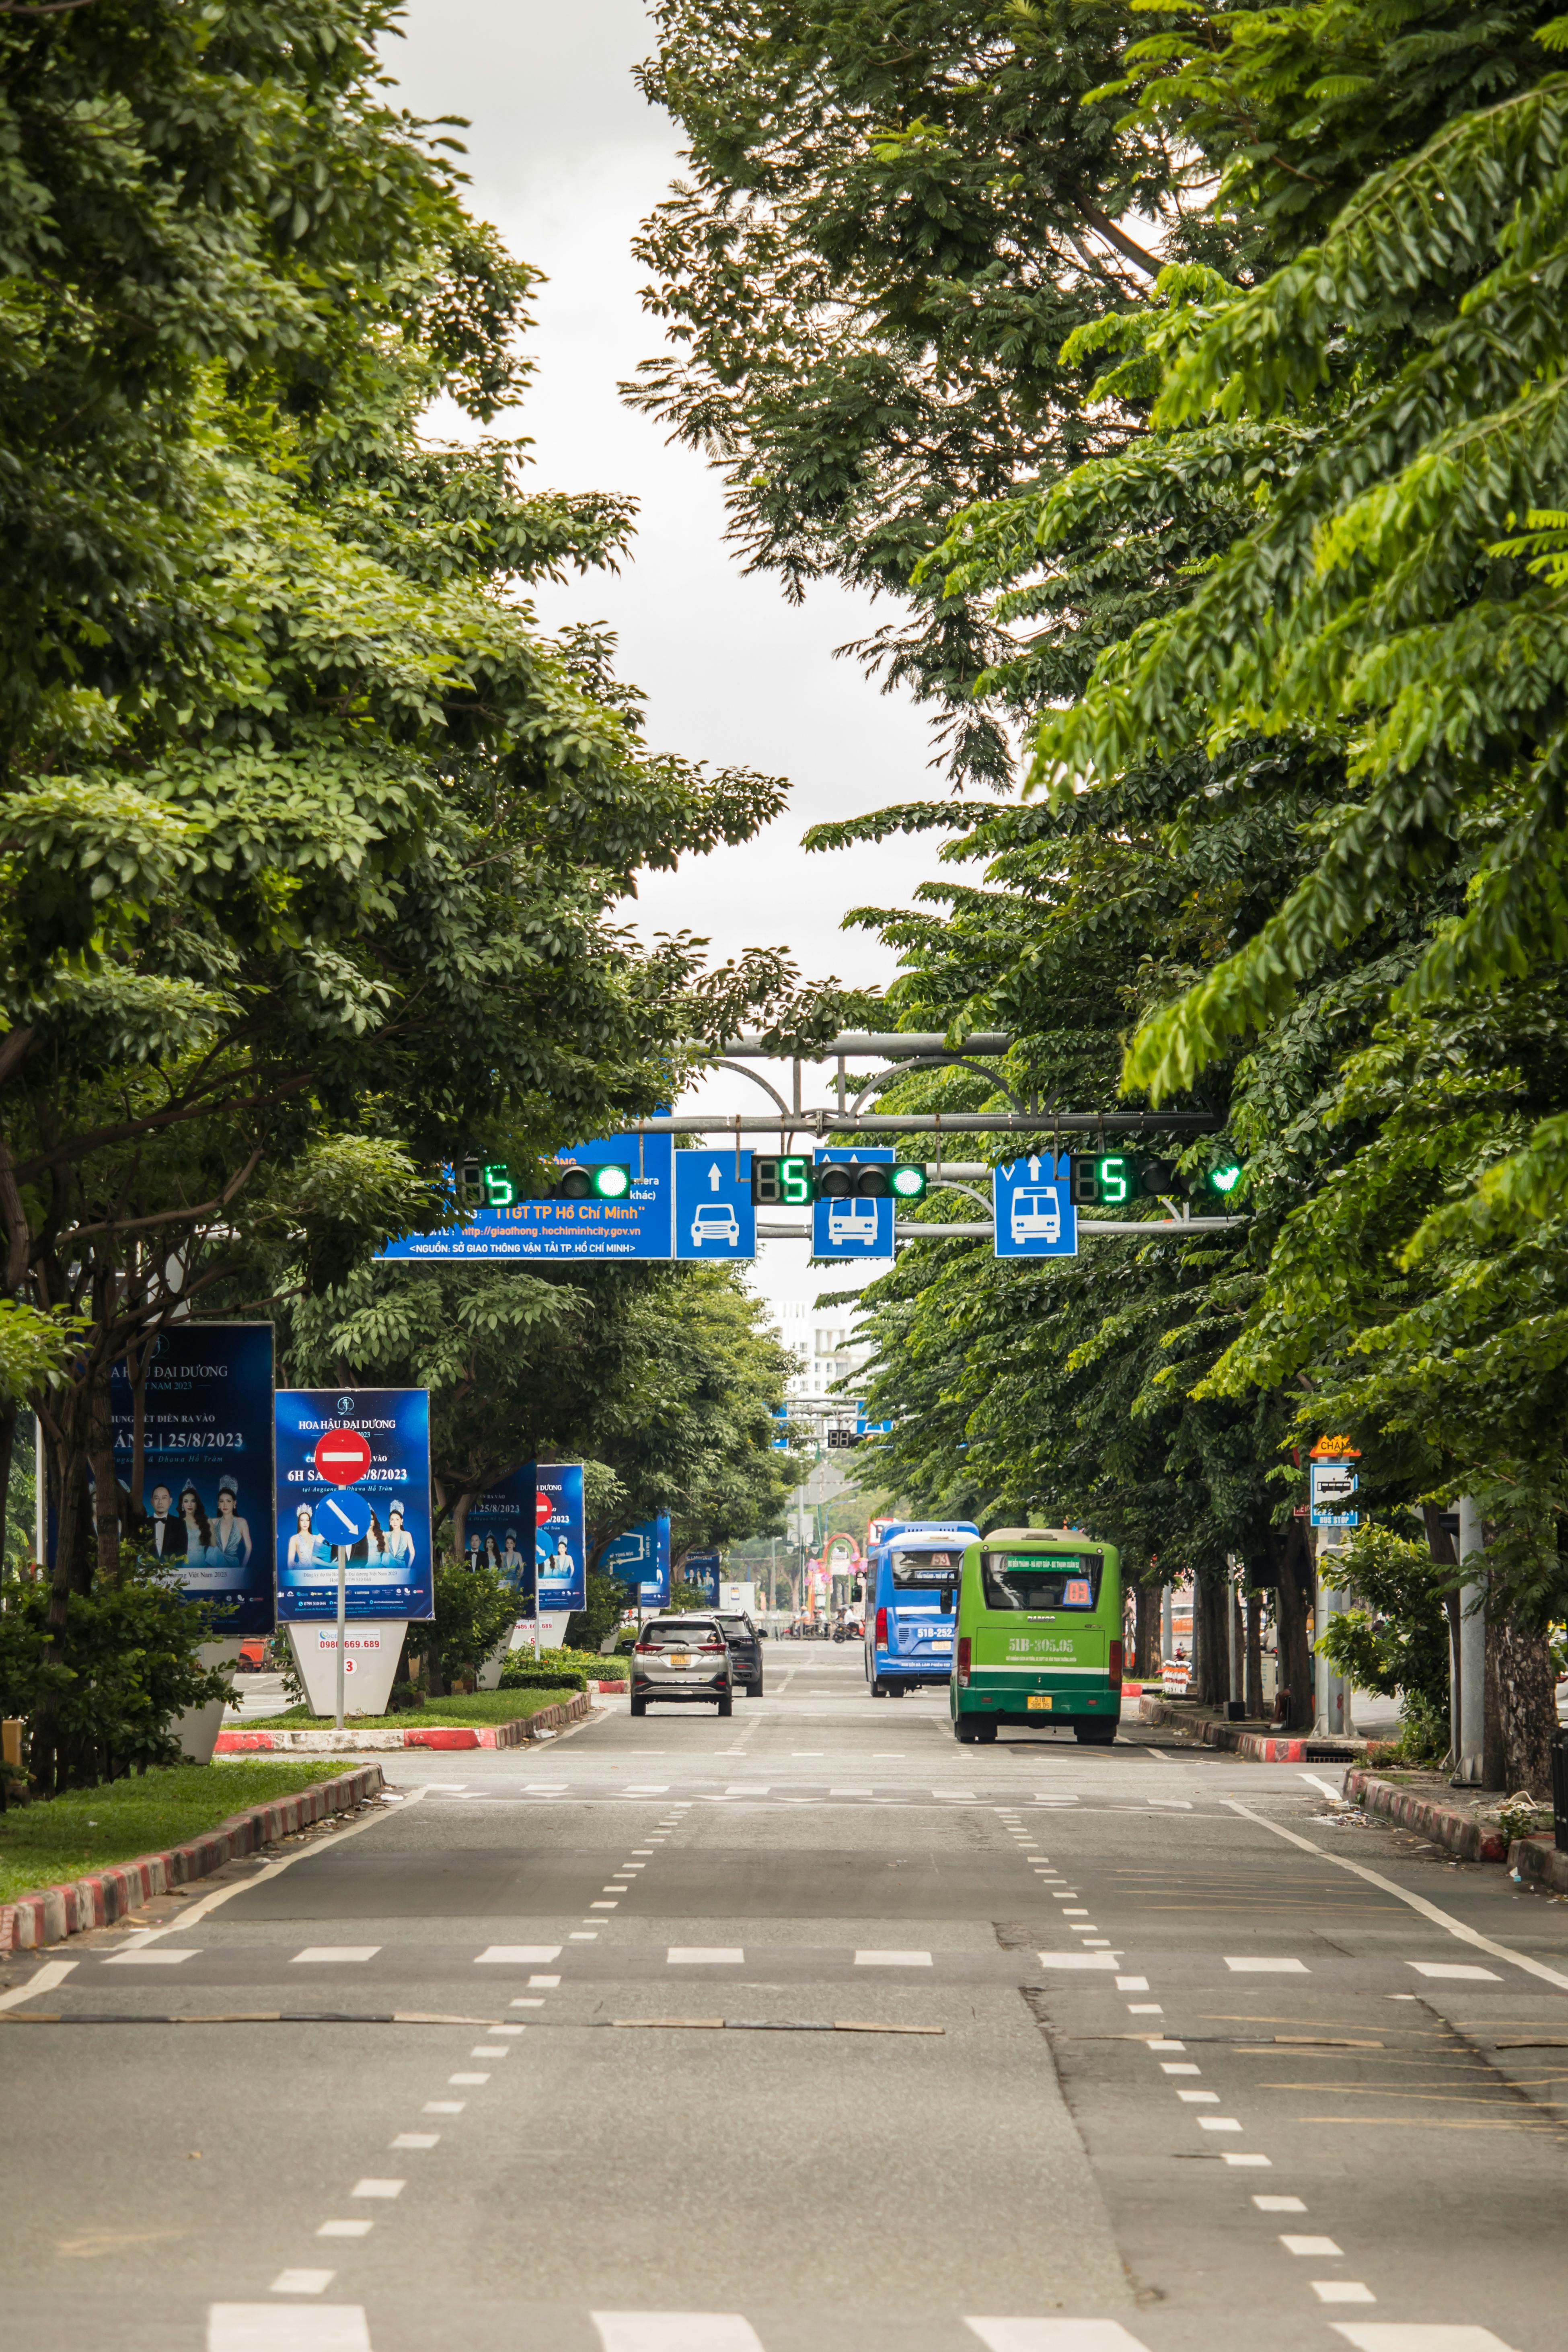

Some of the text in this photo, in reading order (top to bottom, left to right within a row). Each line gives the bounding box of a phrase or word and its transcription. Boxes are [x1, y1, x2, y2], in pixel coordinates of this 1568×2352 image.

[783, 1159, 807, 1202] 5
[1102, 1158, 1126, 1201] 5
[630, 1190, 656, 1201] khác)
[533, 1206, 552, 1219] TP
[556, 1205, 575, 1219] Hồ
[579, 1206, 602, 1219] Chí
[452, 1241, 464, 1252] SỞ
[467, 1244, 488, 1252] GIAO
[490, 1242, 520, 1252] THÔNG
[523, 1242, 541, 1254] VẬN
[545, 1241, 558, 1252] TẢI
[590, 1242, 604, 1252] CHÍ
[154, 1367, 177, 1379] ĐẠI
[181, 1364, 228, 1377] DƯƠNG
[195, 1413, 215, 1422] VÀO
[298, 1418, 396, 1430] HOA HẬU ĐẠI DƯƠNG
[114, 1430, 243, 1447] ÁNG 25/8/2023
[288, 1470, 304, 1481] 6H
[480, 1504, 520, 1512] 25/8/2023
[934, 1554, 947, 1564] 53
[1070, 1583, 1088, 1602] 03
[1009, 1638, 1073, 1653] 51B-305.05
[346, 1661, 353, 1671] 3
